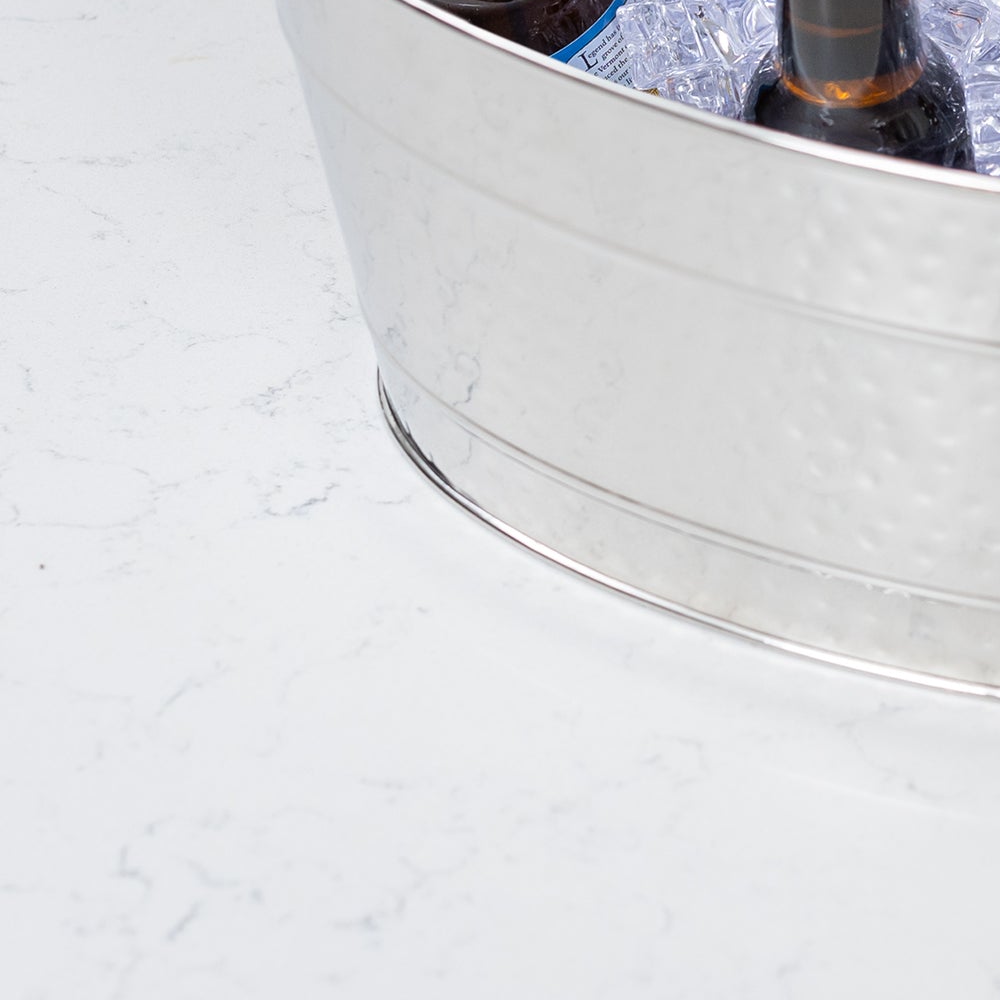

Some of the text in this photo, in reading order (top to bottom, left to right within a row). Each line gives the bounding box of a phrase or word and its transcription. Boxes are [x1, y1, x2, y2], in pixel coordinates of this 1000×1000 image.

[578, 39, 607, 72] Legend
[606, 31, 617, 42] has
[598, 48, 625, 73] Vermont
[601, 42, 618, 61] grove
